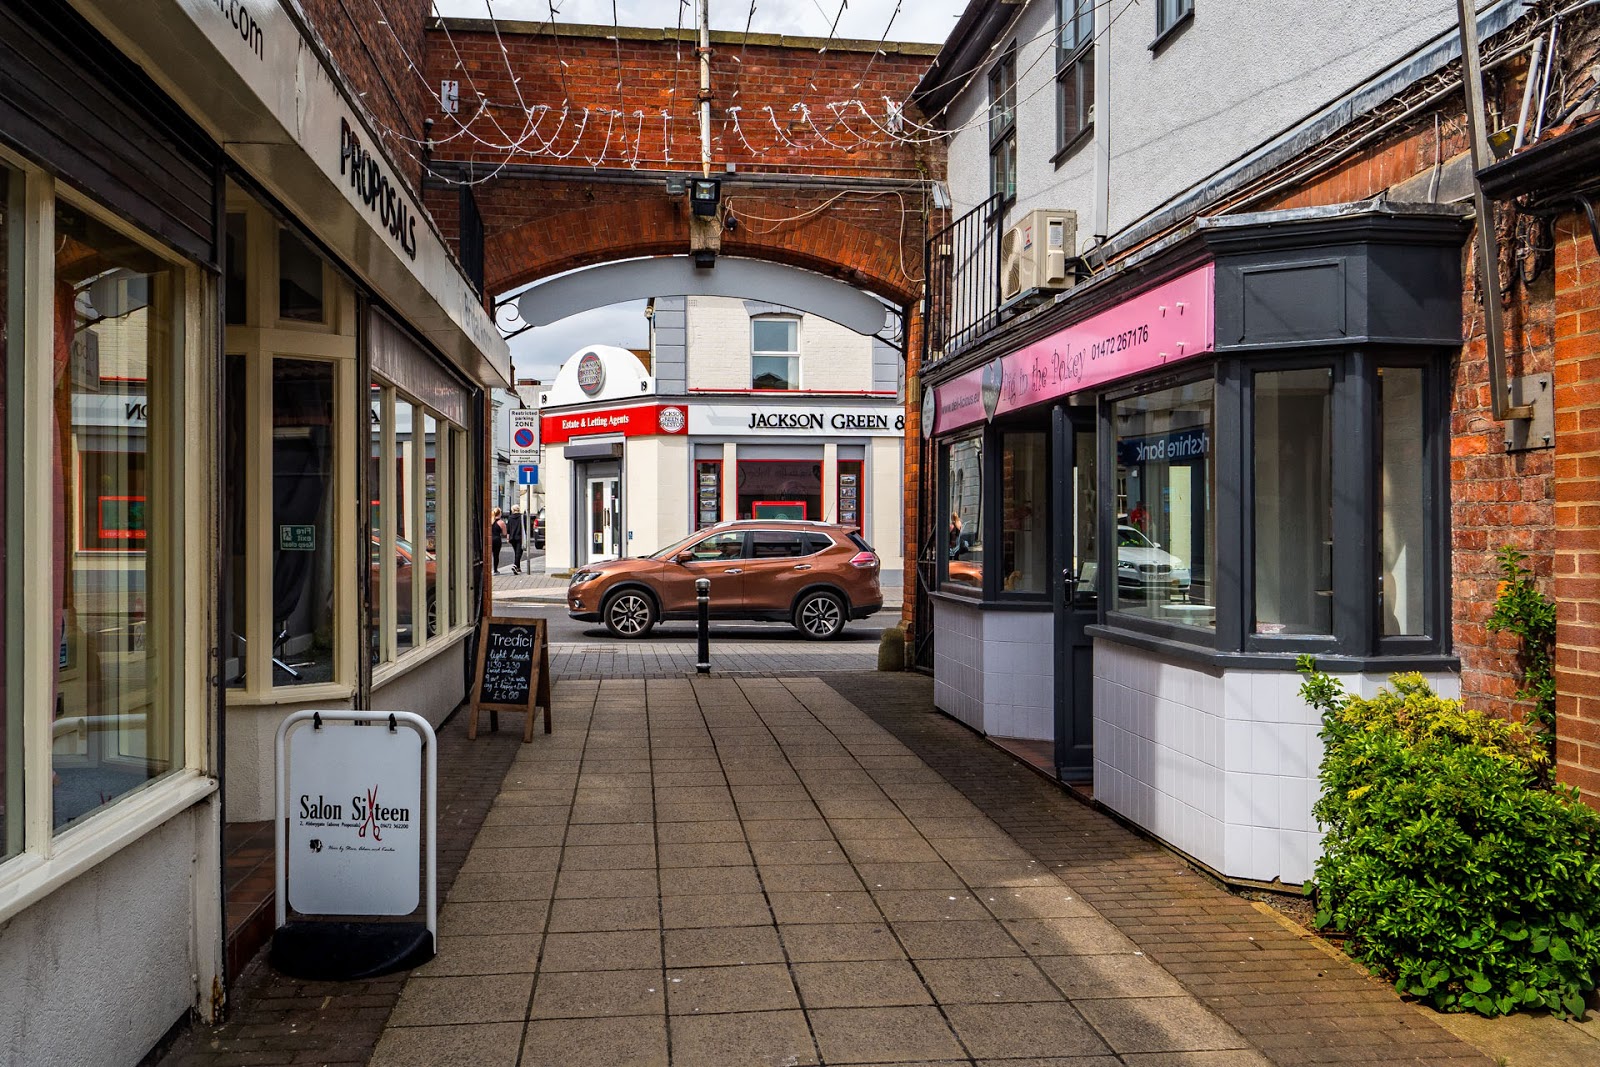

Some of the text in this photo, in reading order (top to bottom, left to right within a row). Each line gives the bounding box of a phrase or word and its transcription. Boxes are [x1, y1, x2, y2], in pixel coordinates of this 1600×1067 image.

[340, 116, 416, 261] PROPOSALS
[1091, 324, 1149, 361] 01472 267176
[1032, 357, 1048, 392] the
[1051, 343, 1086, 388] Pokey
[562, 414, 629, 430] Estate & Letting Agents
[748, 413, 824, 429] JACKSON
[831, 414, 888, 429] GREEN
[894, 414, 904, 430] &
[491, 633, 533, 648] Tredici
[489, 649, 530, 662] light lunch
[300, 794, 409, 822] Salon Sixteen
